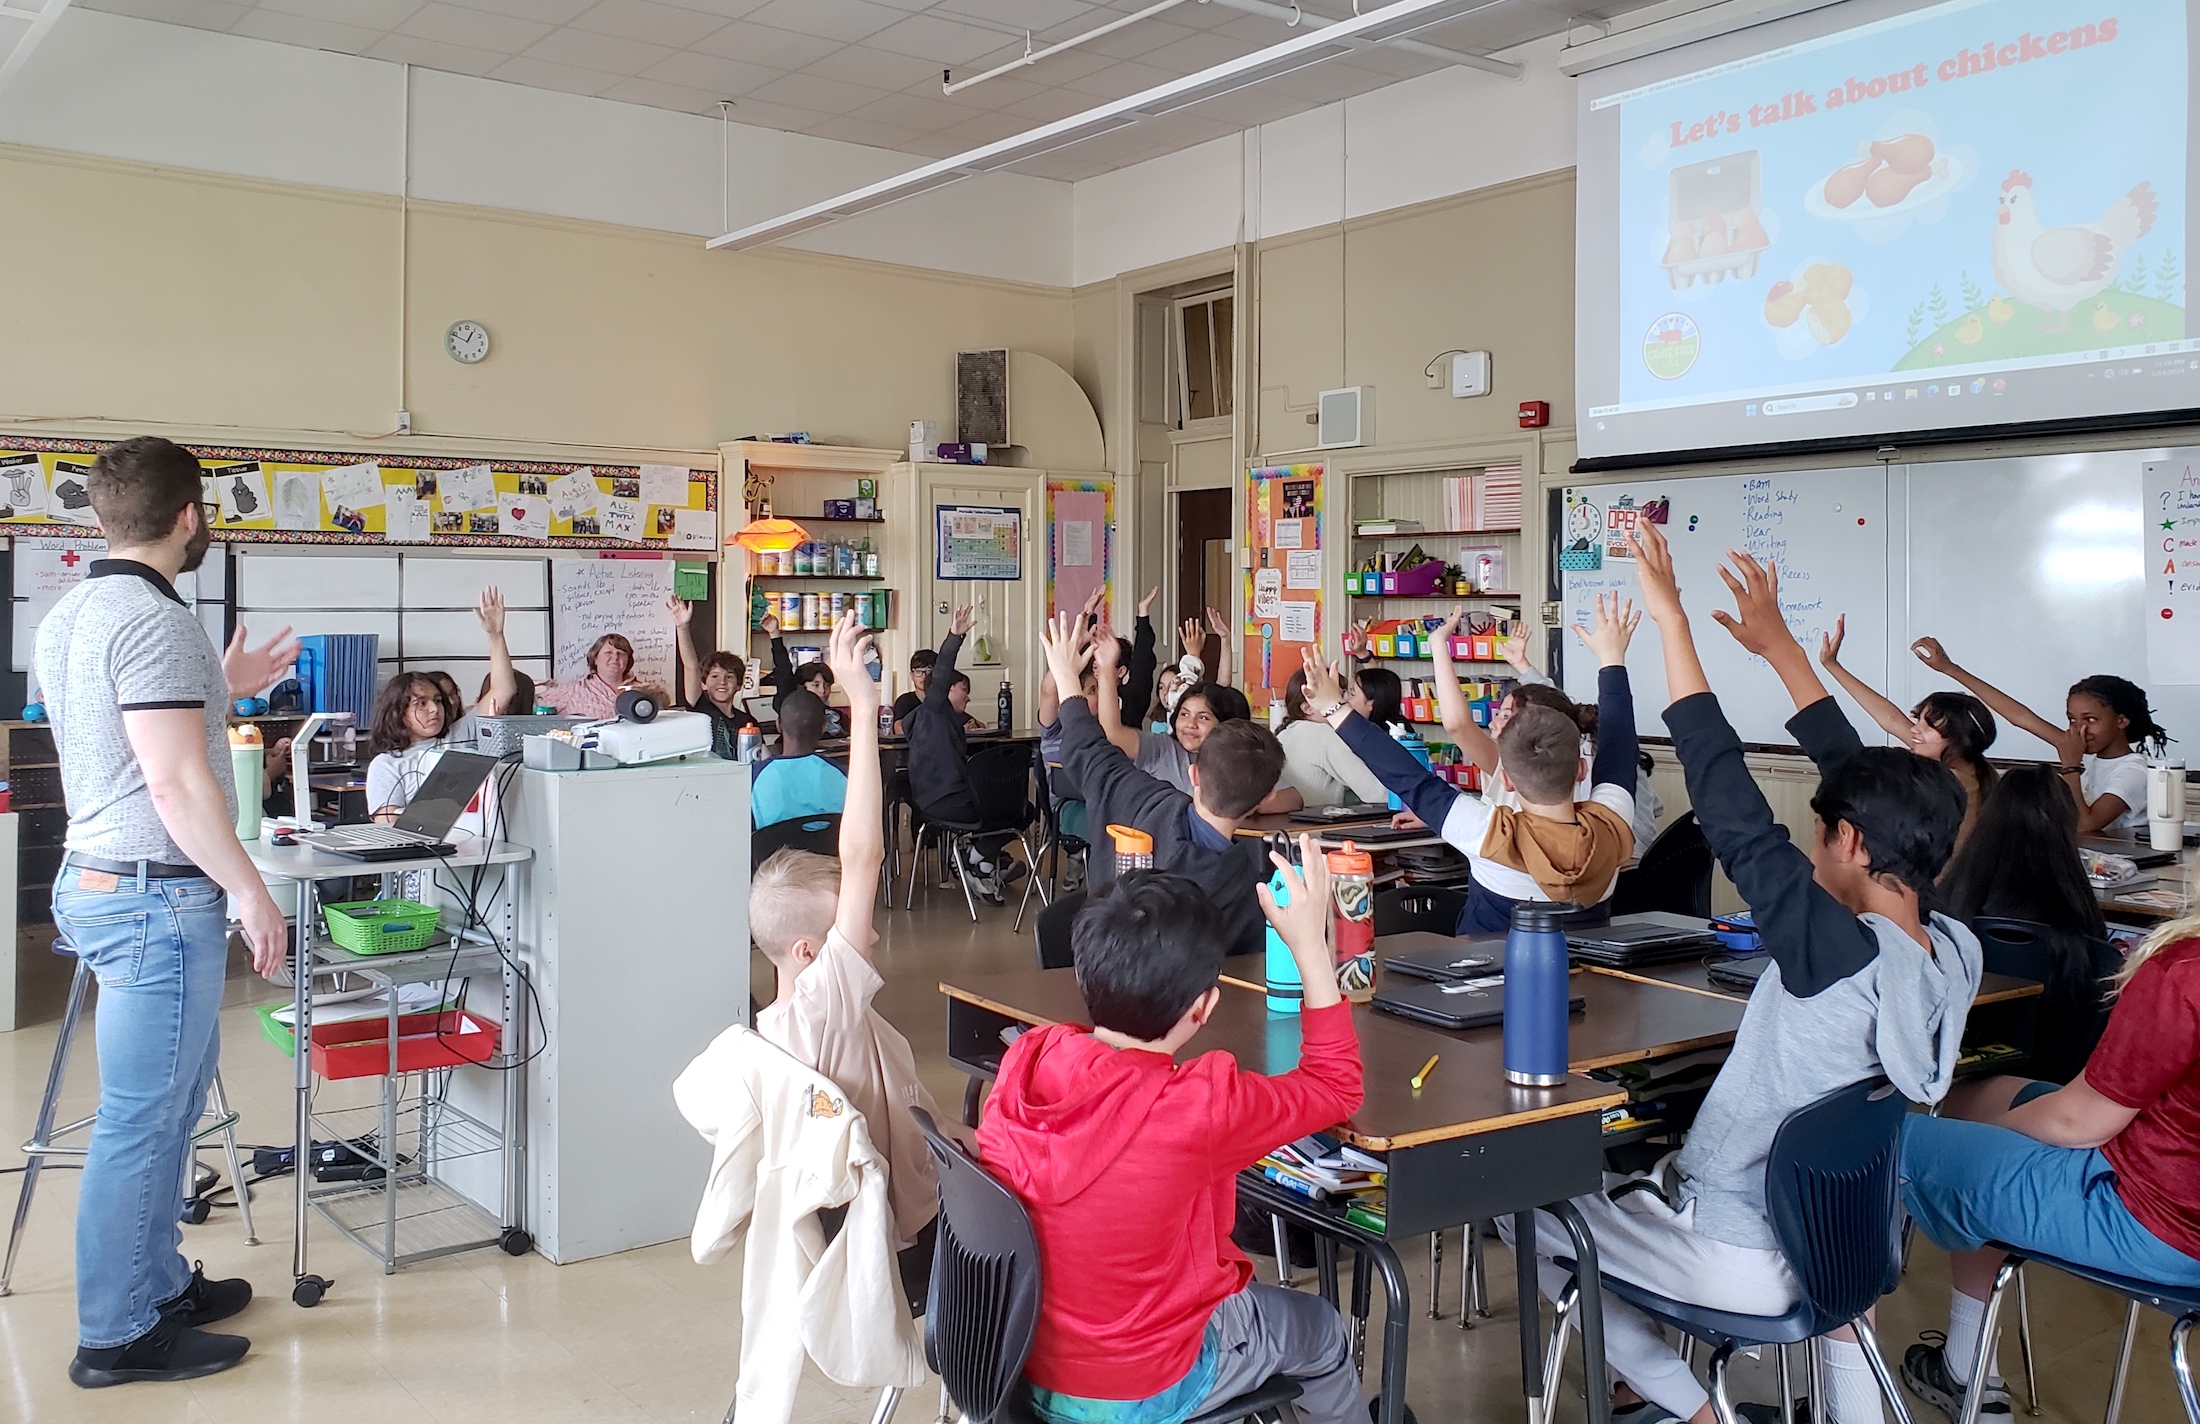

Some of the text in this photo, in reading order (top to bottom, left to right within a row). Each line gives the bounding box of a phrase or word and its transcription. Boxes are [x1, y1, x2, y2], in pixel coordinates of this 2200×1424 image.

[1747, 90, 1819, 129] talk
[1825, 61, 1929, 109] about
[1937, 17, 2119, 83] chickens
[1, 458, 24, 466] Water
[226, 464, 248, 474] Tissue
[71, 465, 89, 474] Penc
[562, 483, 592, 499] August
[1749, 480, 1770, 490] BAM
[1748, 490, 1798, 505] Word Study
[1746, 505, 1783, 524] Reading
[604, 520, 631, 532] MAX
[1746, 524, 1771, 538] Dear
[40, 540, 65, 550] Word
[1748, 535, 1786, 555] Writing
[2163, 537, 2174, 552] C
[590, 562, 654, 586] Active Listening
[1778, 564, 1810, 580] /Recess
[684, 574, 702, 588] Talk
[1258, 582, 1278, 595] Happy
[1796, 628, 1819, 650] arty?
